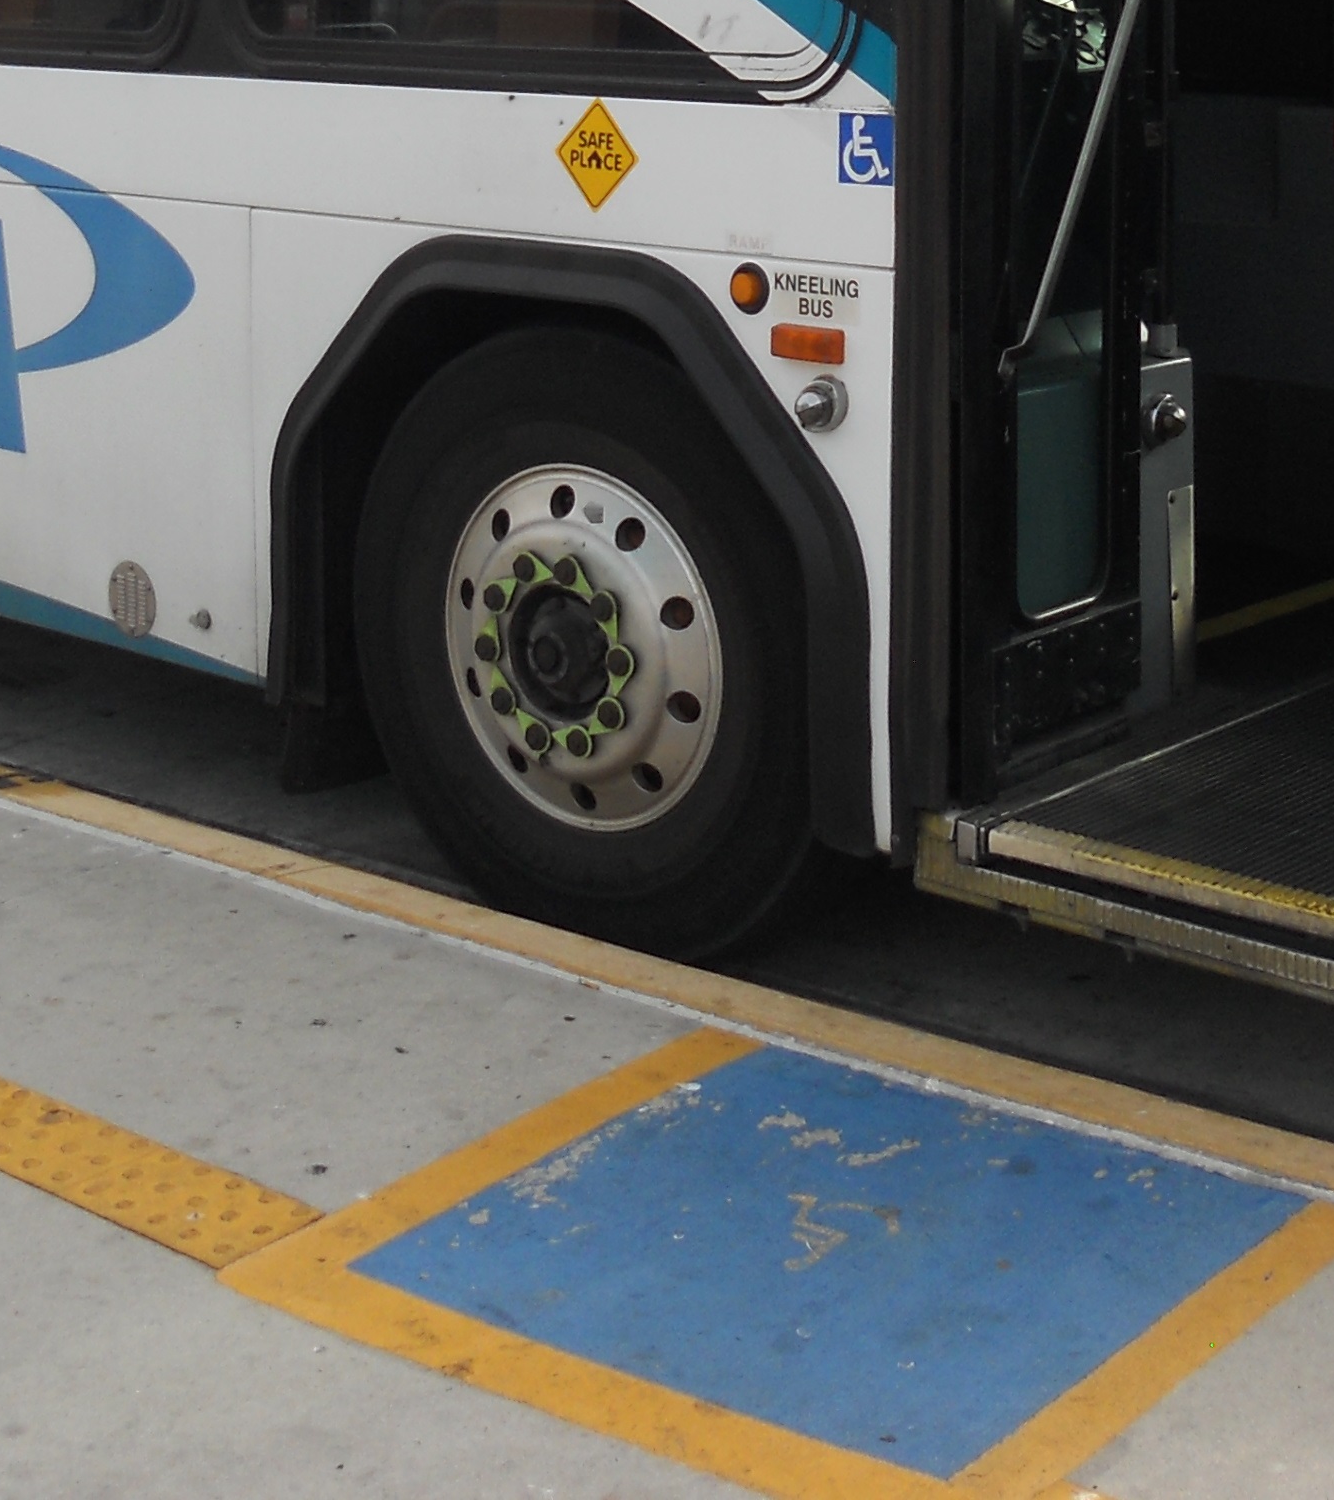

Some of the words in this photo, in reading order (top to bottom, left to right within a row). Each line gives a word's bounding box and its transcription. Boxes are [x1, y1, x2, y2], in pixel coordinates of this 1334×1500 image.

[579, 130, 614, 150] SAFE
[773, 272, 859, 298] KNEELING
[798, 297, 834, 318] BUS
